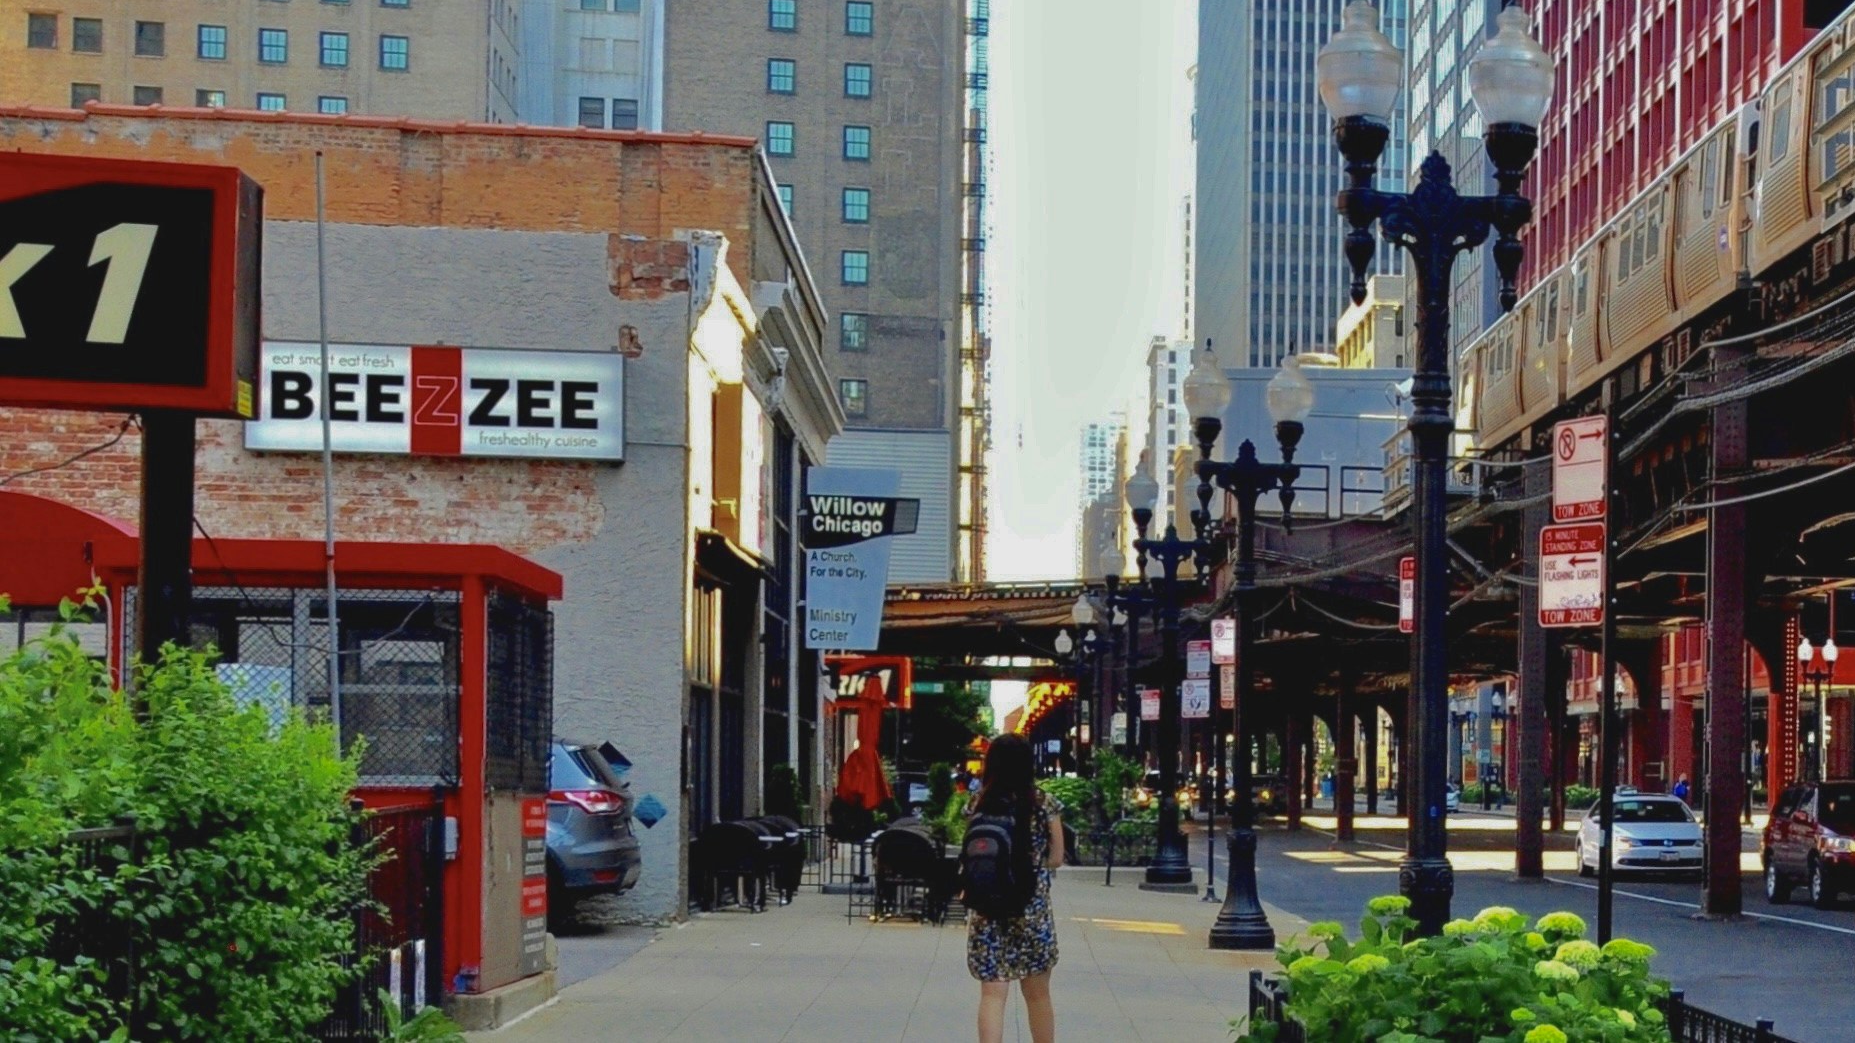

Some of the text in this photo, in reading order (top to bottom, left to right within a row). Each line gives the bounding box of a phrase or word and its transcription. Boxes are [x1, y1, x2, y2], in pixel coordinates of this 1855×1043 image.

[299, 354, 335, 367] smat
[479, 430, 598, 449] freshealthy cuisine
[810, 496, 886, 517] Willow
[1557, 503, 1600, 518] TOW ZONE
[812, 515, 883, 537] Chicago
[1545, 540, 1597, 553] STANDING ZONE
[810, 551, 819, 561] A
[1544, 560, 1557, 571] USE
[810, 566, 868, 581] For the City.
[1544, 567, 1599, 582] FLASHING LIGHTS
[809, 609, 858, 624] Ministry
[1543, 609, 1597, 624] TOW ZONE
[809, 629, 848, 642] Center
